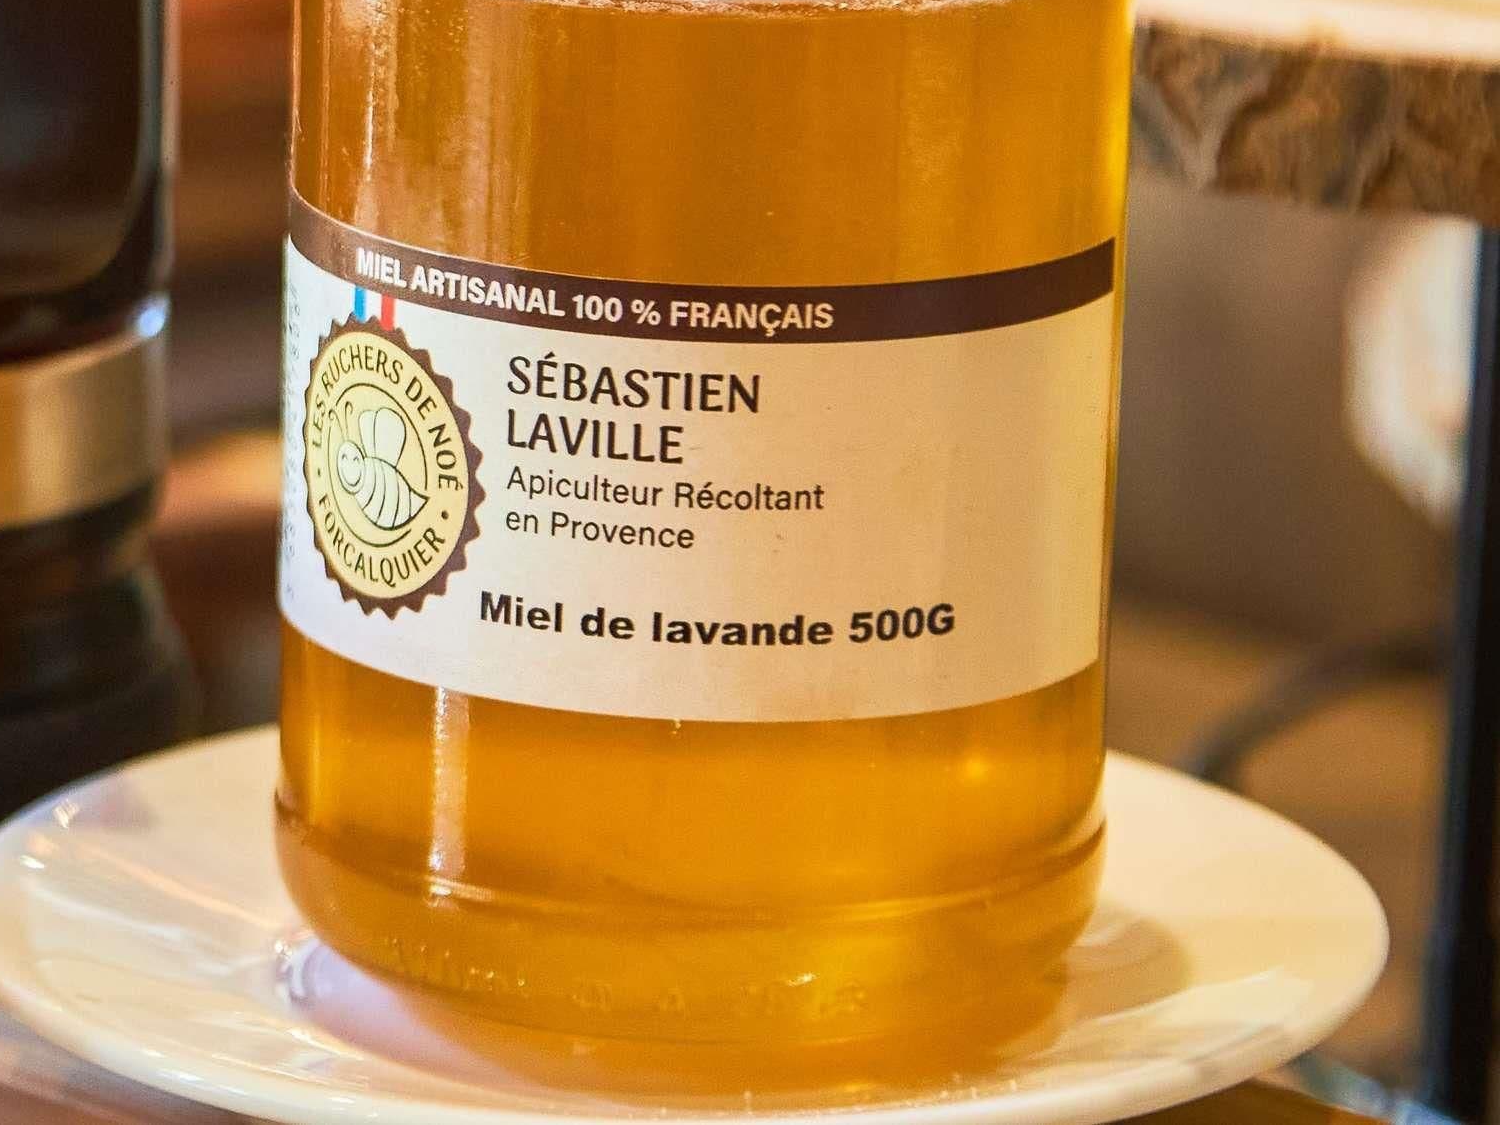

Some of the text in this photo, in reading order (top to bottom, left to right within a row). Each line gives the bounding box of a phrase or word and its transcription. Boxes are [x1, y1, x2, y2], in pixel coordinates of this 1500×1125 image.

[354, 246, 835, 338] MIEL ARTISANAL 100 % FRANÇAIS
[506, 351, 762, 414] SÉBASTIEN
[311, 343, 464, 492] LES RUCHERS DE NOÉ
[506, 407, 684, 465] LAVILLE
[506, 465, 826, 511] Apiculteur Récoltant
[317, 492, 447, 589] FORCALQUIER
[505, 509, 696, 550] en Provence
[478, 589, 956, 648] Miel de lavande 500G
